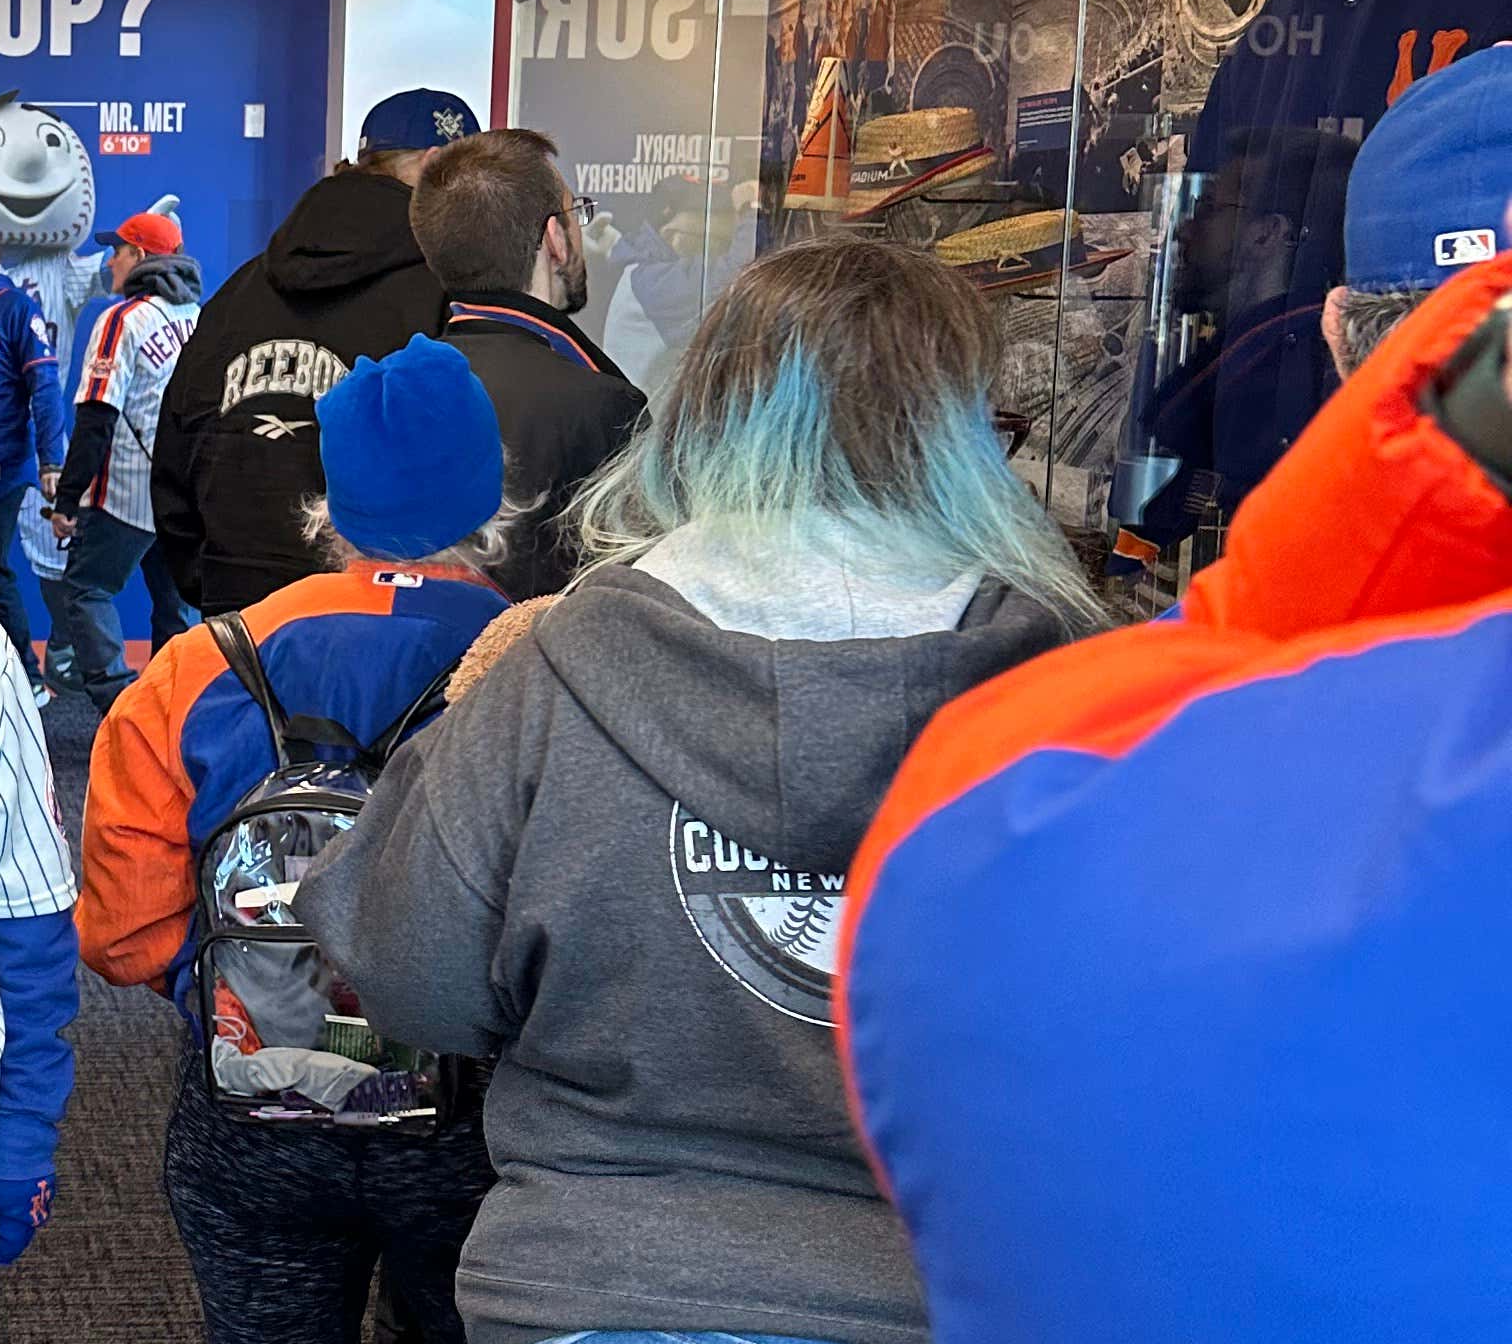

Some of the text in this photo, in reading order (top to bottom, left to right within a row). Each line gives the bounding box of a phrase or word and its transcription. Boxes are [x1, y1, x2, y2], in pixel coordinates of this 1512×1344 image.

[99, 102, 187, 133] MR. MET
[772, 873, 846, 892] NEW
